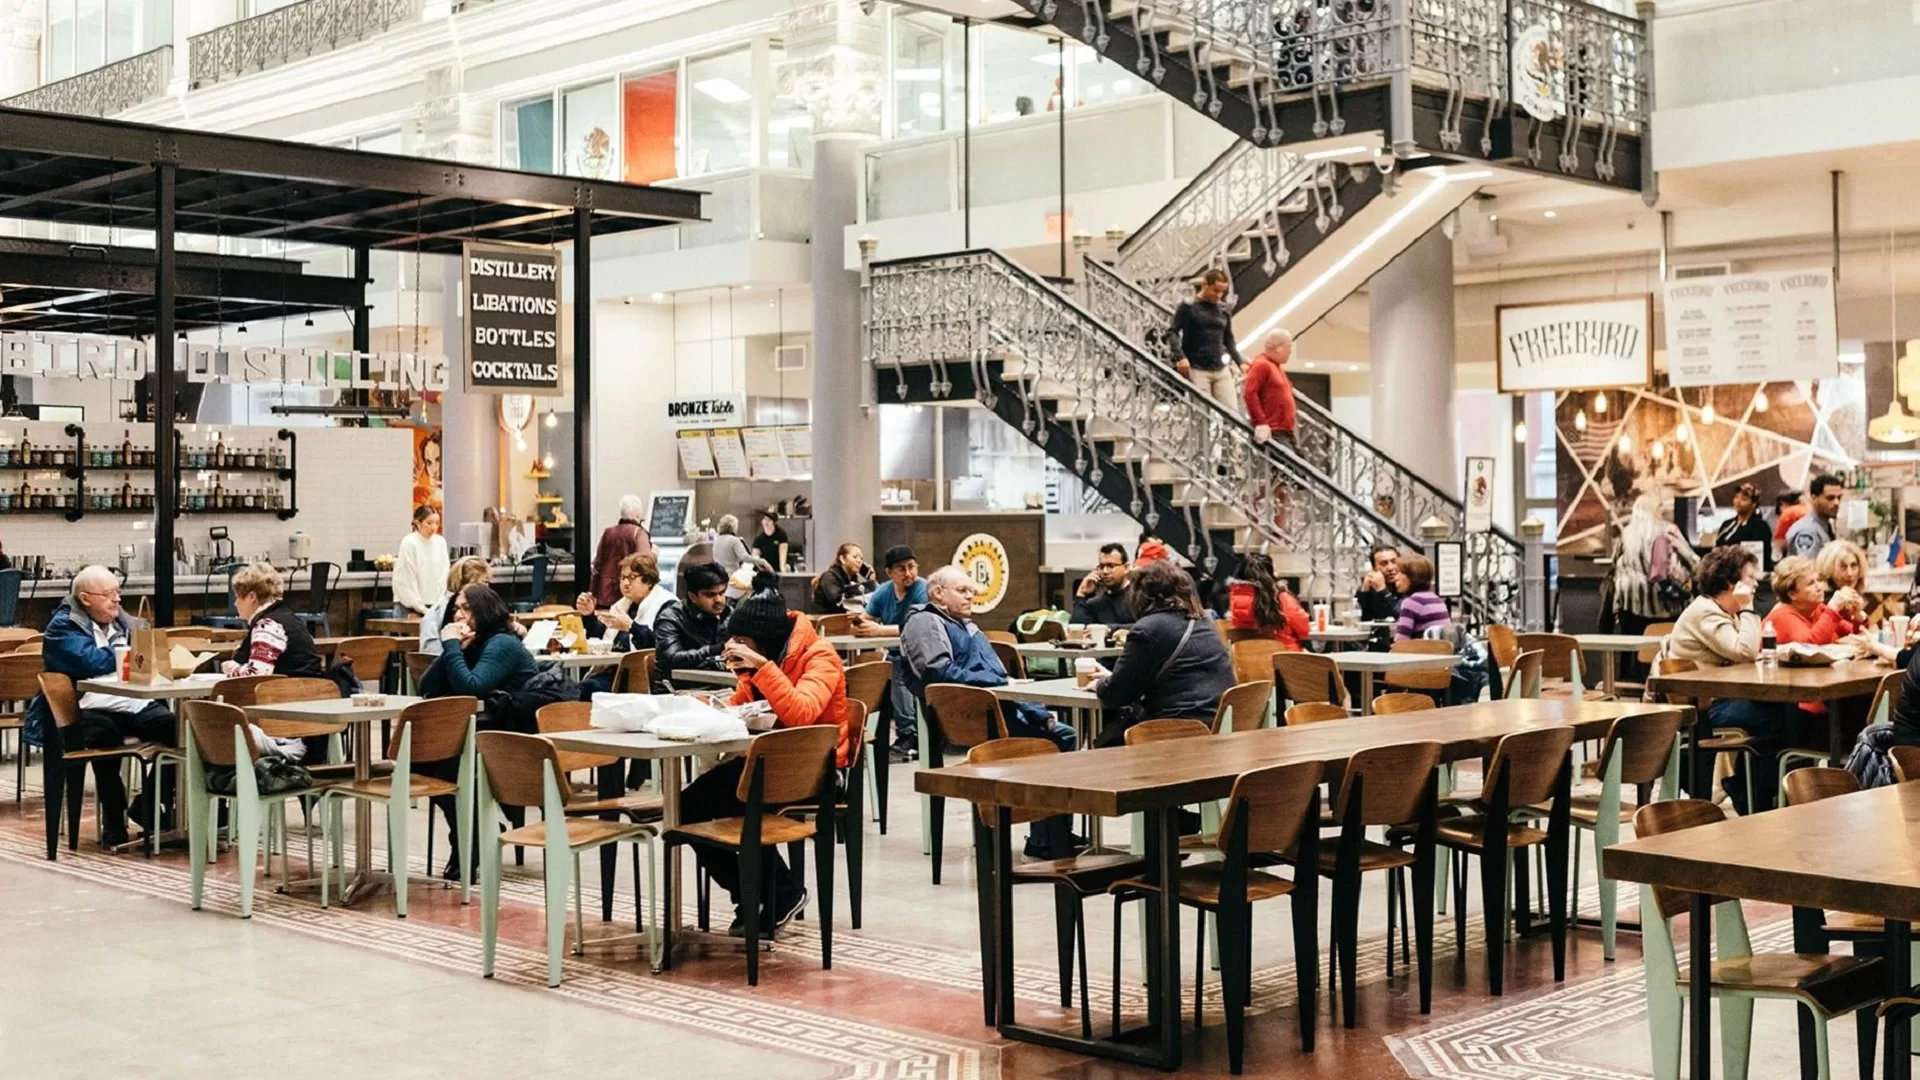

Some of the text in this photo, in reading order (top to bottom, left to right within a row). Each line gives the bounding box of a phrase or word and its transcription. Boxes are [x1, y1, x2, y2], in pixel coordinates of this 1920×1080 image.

[469, 258, 557, 281] DISTILLERY
[472, 293, 557, 315] LIBATIONS
[475, 327, 556, 348] BOTTLES
[1509, 319, 1639, 368] FREEBYRD
[2, 331, 449, 391] BIRD DISTILLING
[472, 361, 558, 381] COCKTAILS
[668, 399, 734, 417] BRONZE Table
